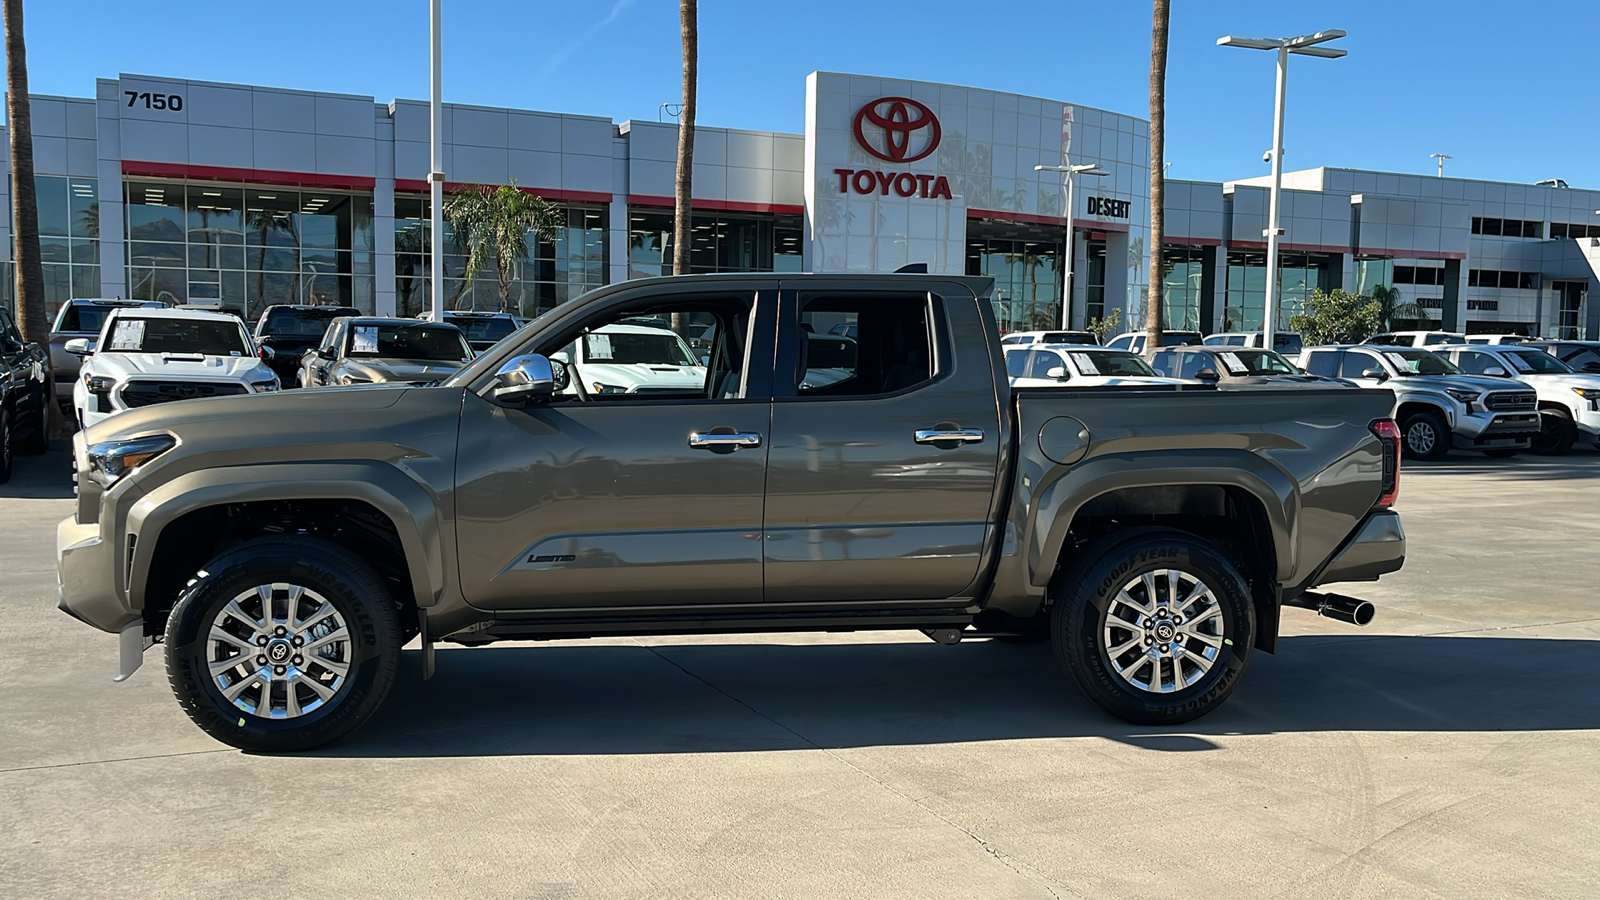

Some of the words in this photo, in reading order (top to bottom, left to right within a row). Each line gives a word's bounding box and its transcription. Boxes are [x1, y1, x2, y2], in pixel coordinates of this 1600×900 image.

[124, 91, 183, 111] 7150
[833, 168, 953, 199] TOYOTA
[1087, 196, 1131, 219] DESERT
[1417, 298, 1443, 309] SERVI
